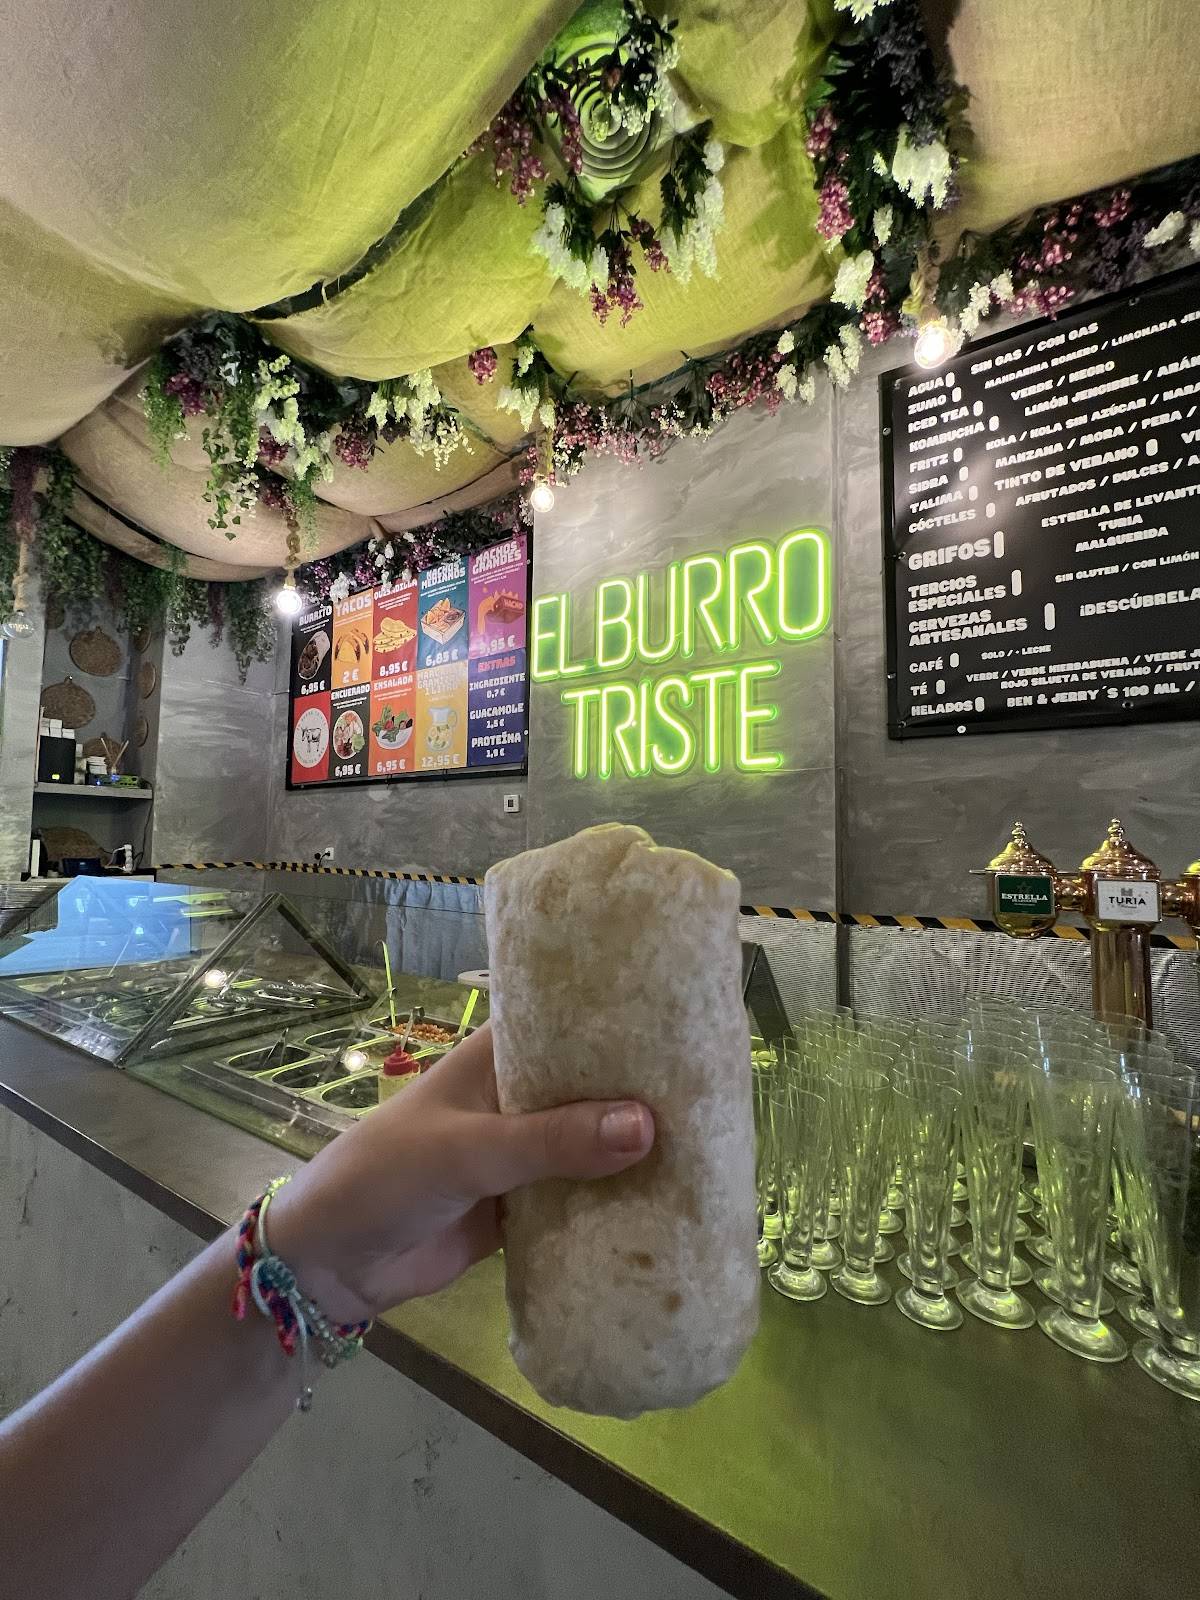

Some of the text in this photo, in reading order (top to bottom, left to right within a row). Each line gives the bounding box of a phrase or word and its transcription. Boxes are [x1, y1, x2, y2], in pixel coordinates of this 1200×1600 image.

[971, 359, 992, 375] SIN
[995, 348, 1022, 366] GAS
[1037, 334, 1065, 351] CON
[1068, 322, 1099, 341] GAS
[984, 361, 1049, 389] MANDARINA
[1111, 319, 1177, 346] LIMONADA
[908, 377, 944, 397] AGUA
[1011, 379, 1053, 400] VERDE
[1069, 361, 1115, 383] NEGRO
[908, 394, 946, 415] ZUMO
[1025, 395, 1068, 416] LIMÓN
[1071, 374, 1139, 403] JENGIBRE
[908, 406, 969, 433] ICED TEA
[986, 434, 1016, 450] KOLA
[1030, 422, 1063, 438] KOLA
[1065, 414, 1088, 429] SIN
[1091, 398, 1146, 421] AZÚCAR
[909, 421, 985, 452] KOMBUCHA
[995, 442, 1064, 468] MANZANA
[1080, 426, 1124, 446] MORA
[1141, 410, 1183, 429] PERA
[910, 453, 948, 473] FRITZ
[994, 445, 1139, 490] TINTO DE VERANO
[909, 475, 948, 494] SIDRA
[1015, 478, 1097, 506] AFRUTADOS
[1112, 462, 1169, 483] DULCES
[908, 508, 976, 533] CÓCTELES
[1041, 504, 1110, 528] ESTRELLA
[1113, 499, 1132, 512] DE
[1098, 514, 1144, 532] TURIA
[472, 549, 522, 575] GRANDES
[908, 538, 991, 570] GRIFOS
[1055, 573, 1074, 583] SIN
[1076, 565, 1120, 579] GLUTEN
[1132, 559, 1157, 570] CON
[1160, 551, 1200, 565] LIMÓN
[908, 575, 977, 598] TERCIOS
[336, 595, 372, 617] TACOS
[532, 529, 829, 680] EL BURRO
[908, 585, 1006, 613] ESPECIALES
[908, 609, 992, 633] CERVEZAS
[909, 617, 1028, 646] ARTESANALES
[909, 656, 944, 673] CAFÉ
[981, 651, 1005, 660] SOLO
[1021, 645, 1051, 655] LECHE
[343, 671, 350, 684] 2
[966, 671, 999, 682] VERDE
[1011, 666, 1046, 677] VERDE
[1048, 656, 1130, 673] HIERBABUENA
[1144, 650, 1187, 663] VERDE
[1000, 679, 1029, 689] ROJO
[1082, 672, 1097, 681] DE
[1100, 666, 1151, 679] VERANO
[331, 683, 371, 700] ENCUERADO
[373, 675, 413, 691] ENSALADA
[910, 682, 928, 696] TÉ
[1007, 695, 1033, 707] BEN
[1036, 694, 1048, 704] &
[1122, 685, 1149, 697] 100
[1153, 683, 1180, 695] ML
[469, 702, 525, 720] GUACAMOLE
[561, 661, 782, 778] TRISTE
[911, 700, 973, 717] HELADOS
[1001, 892, 1049, 901] ESTRELLA
[1108, 896, 1146, 905] TURIA
